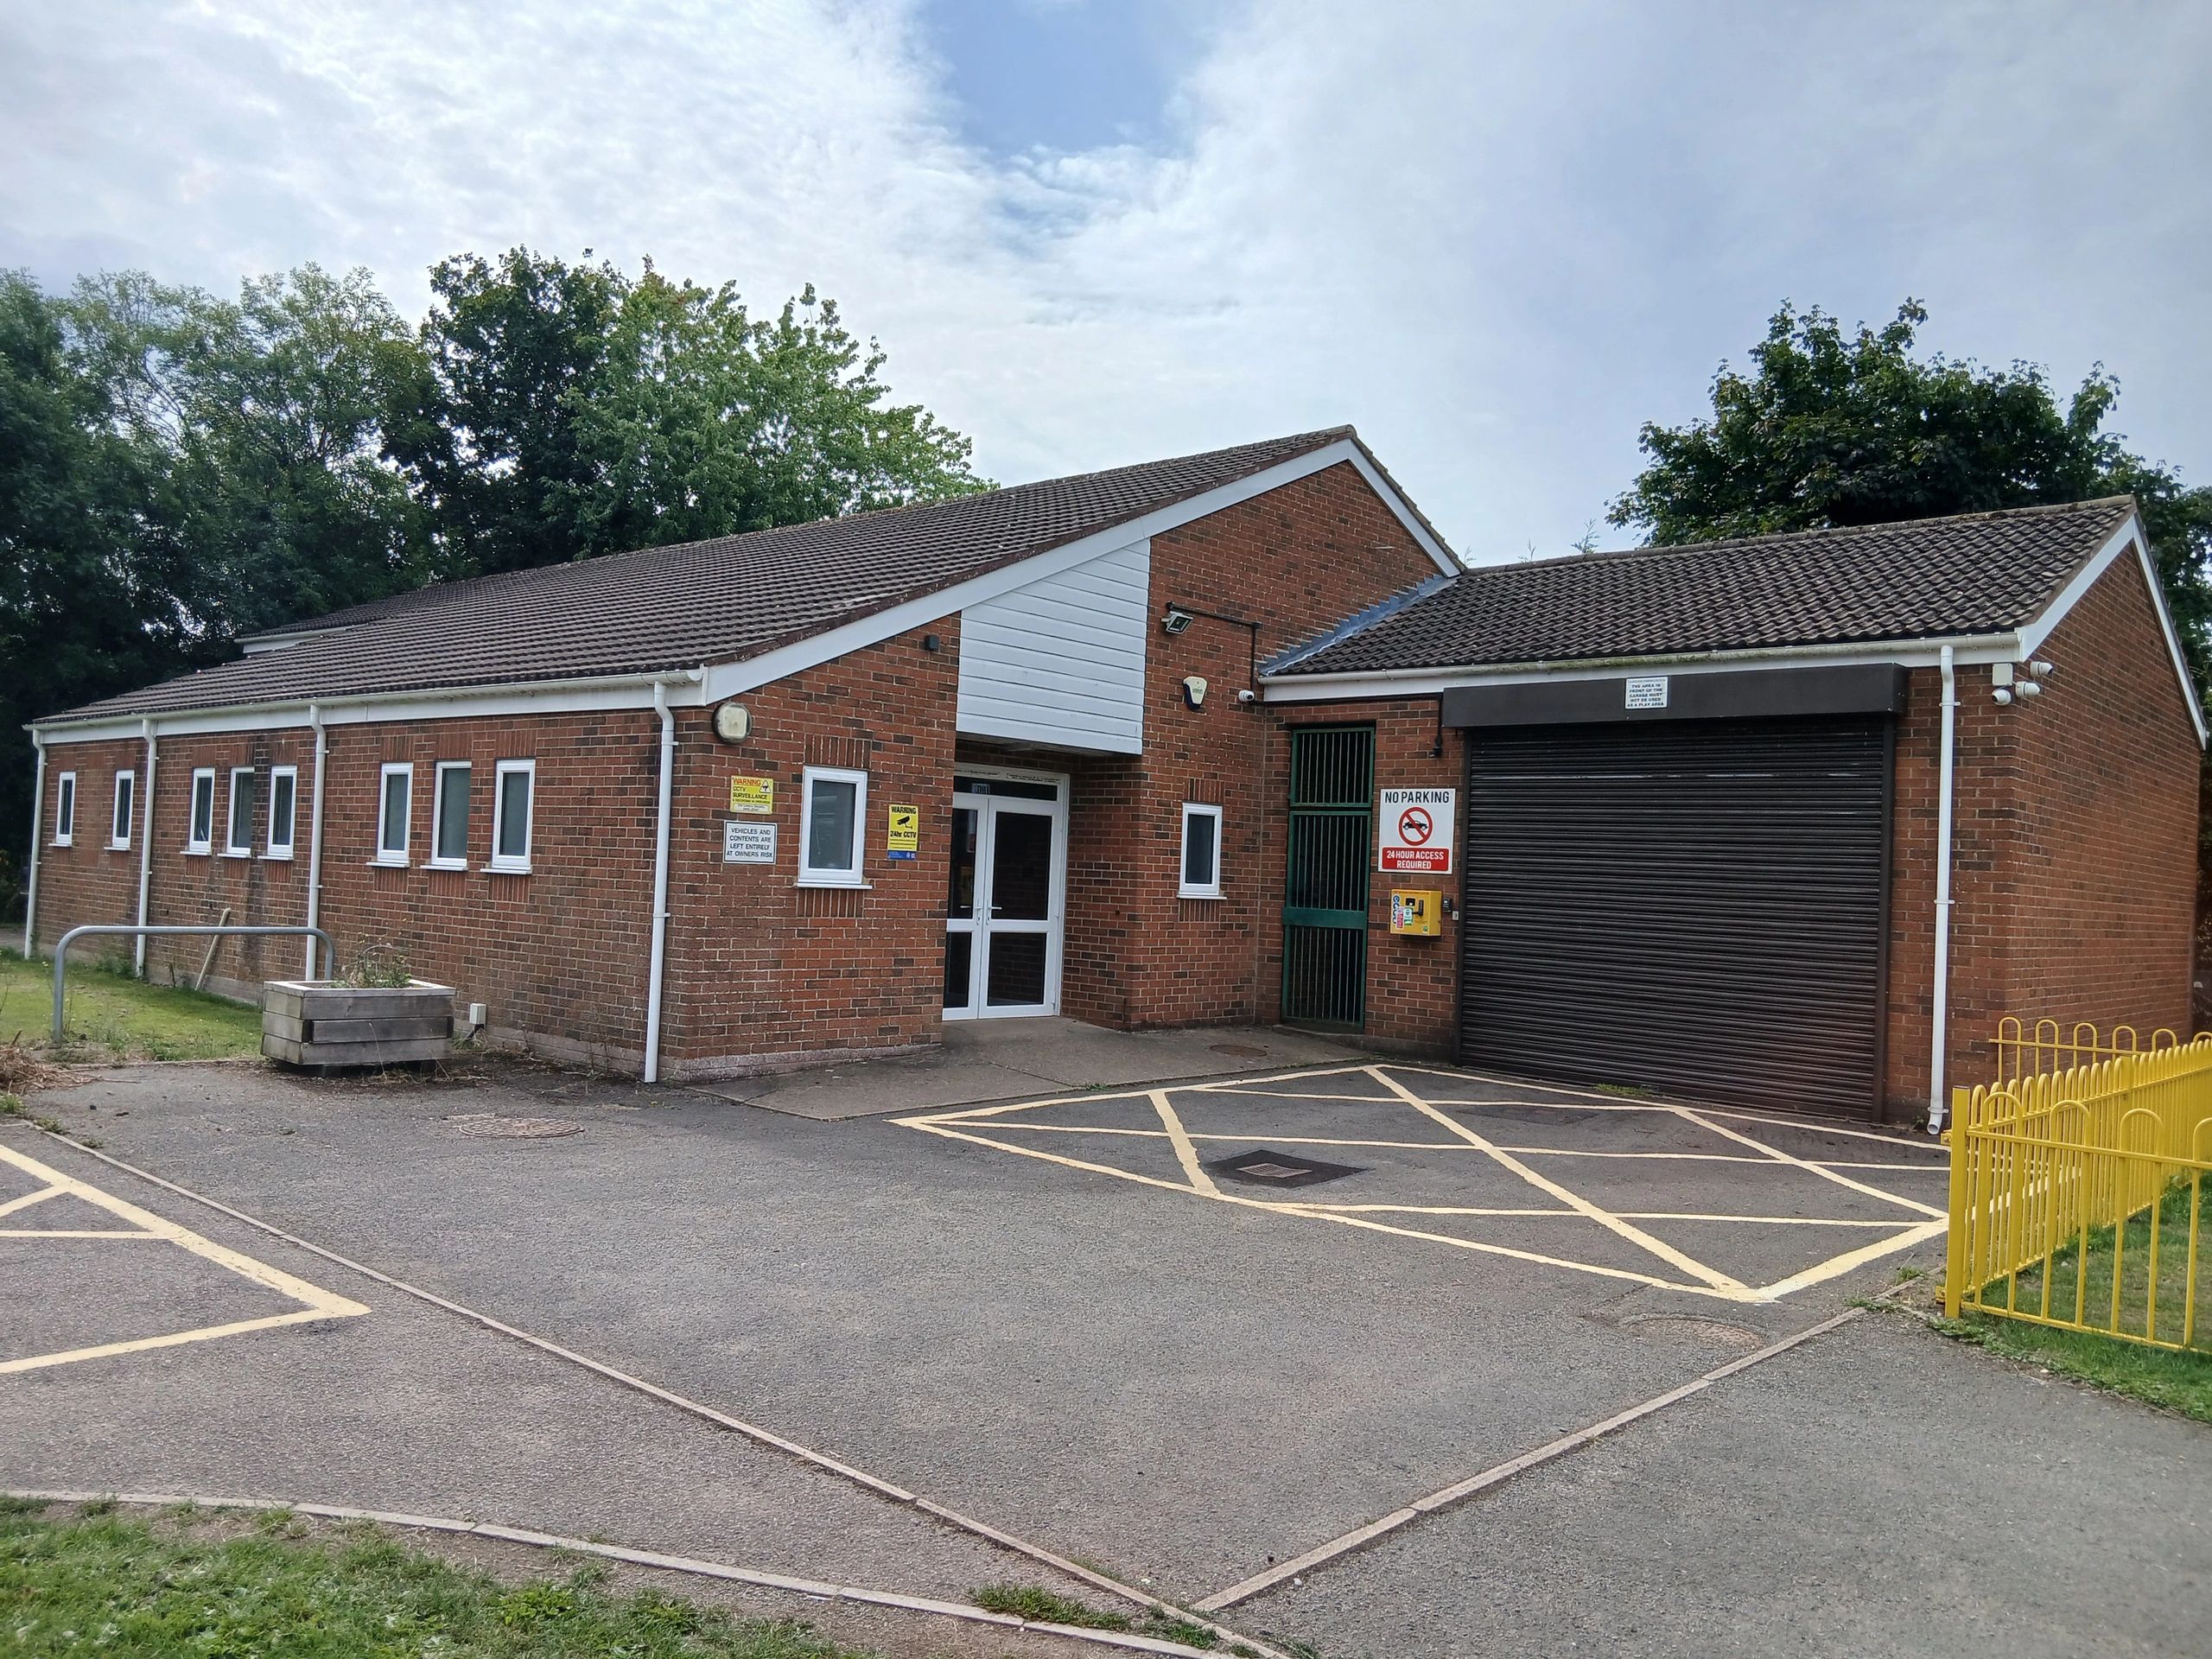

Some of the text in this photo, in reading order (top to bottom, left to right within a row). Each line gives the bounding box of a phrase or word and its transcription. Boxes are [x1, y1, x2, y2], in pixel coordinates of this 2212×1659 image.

[733, 778, 761, 786] WARNING
[1384, 791, 1450, 804] NO PARKING
[1387, 850, 1445, 860] 24 HOUR ACCESS
[1396, 860, 1432, 869] REQUIRED
